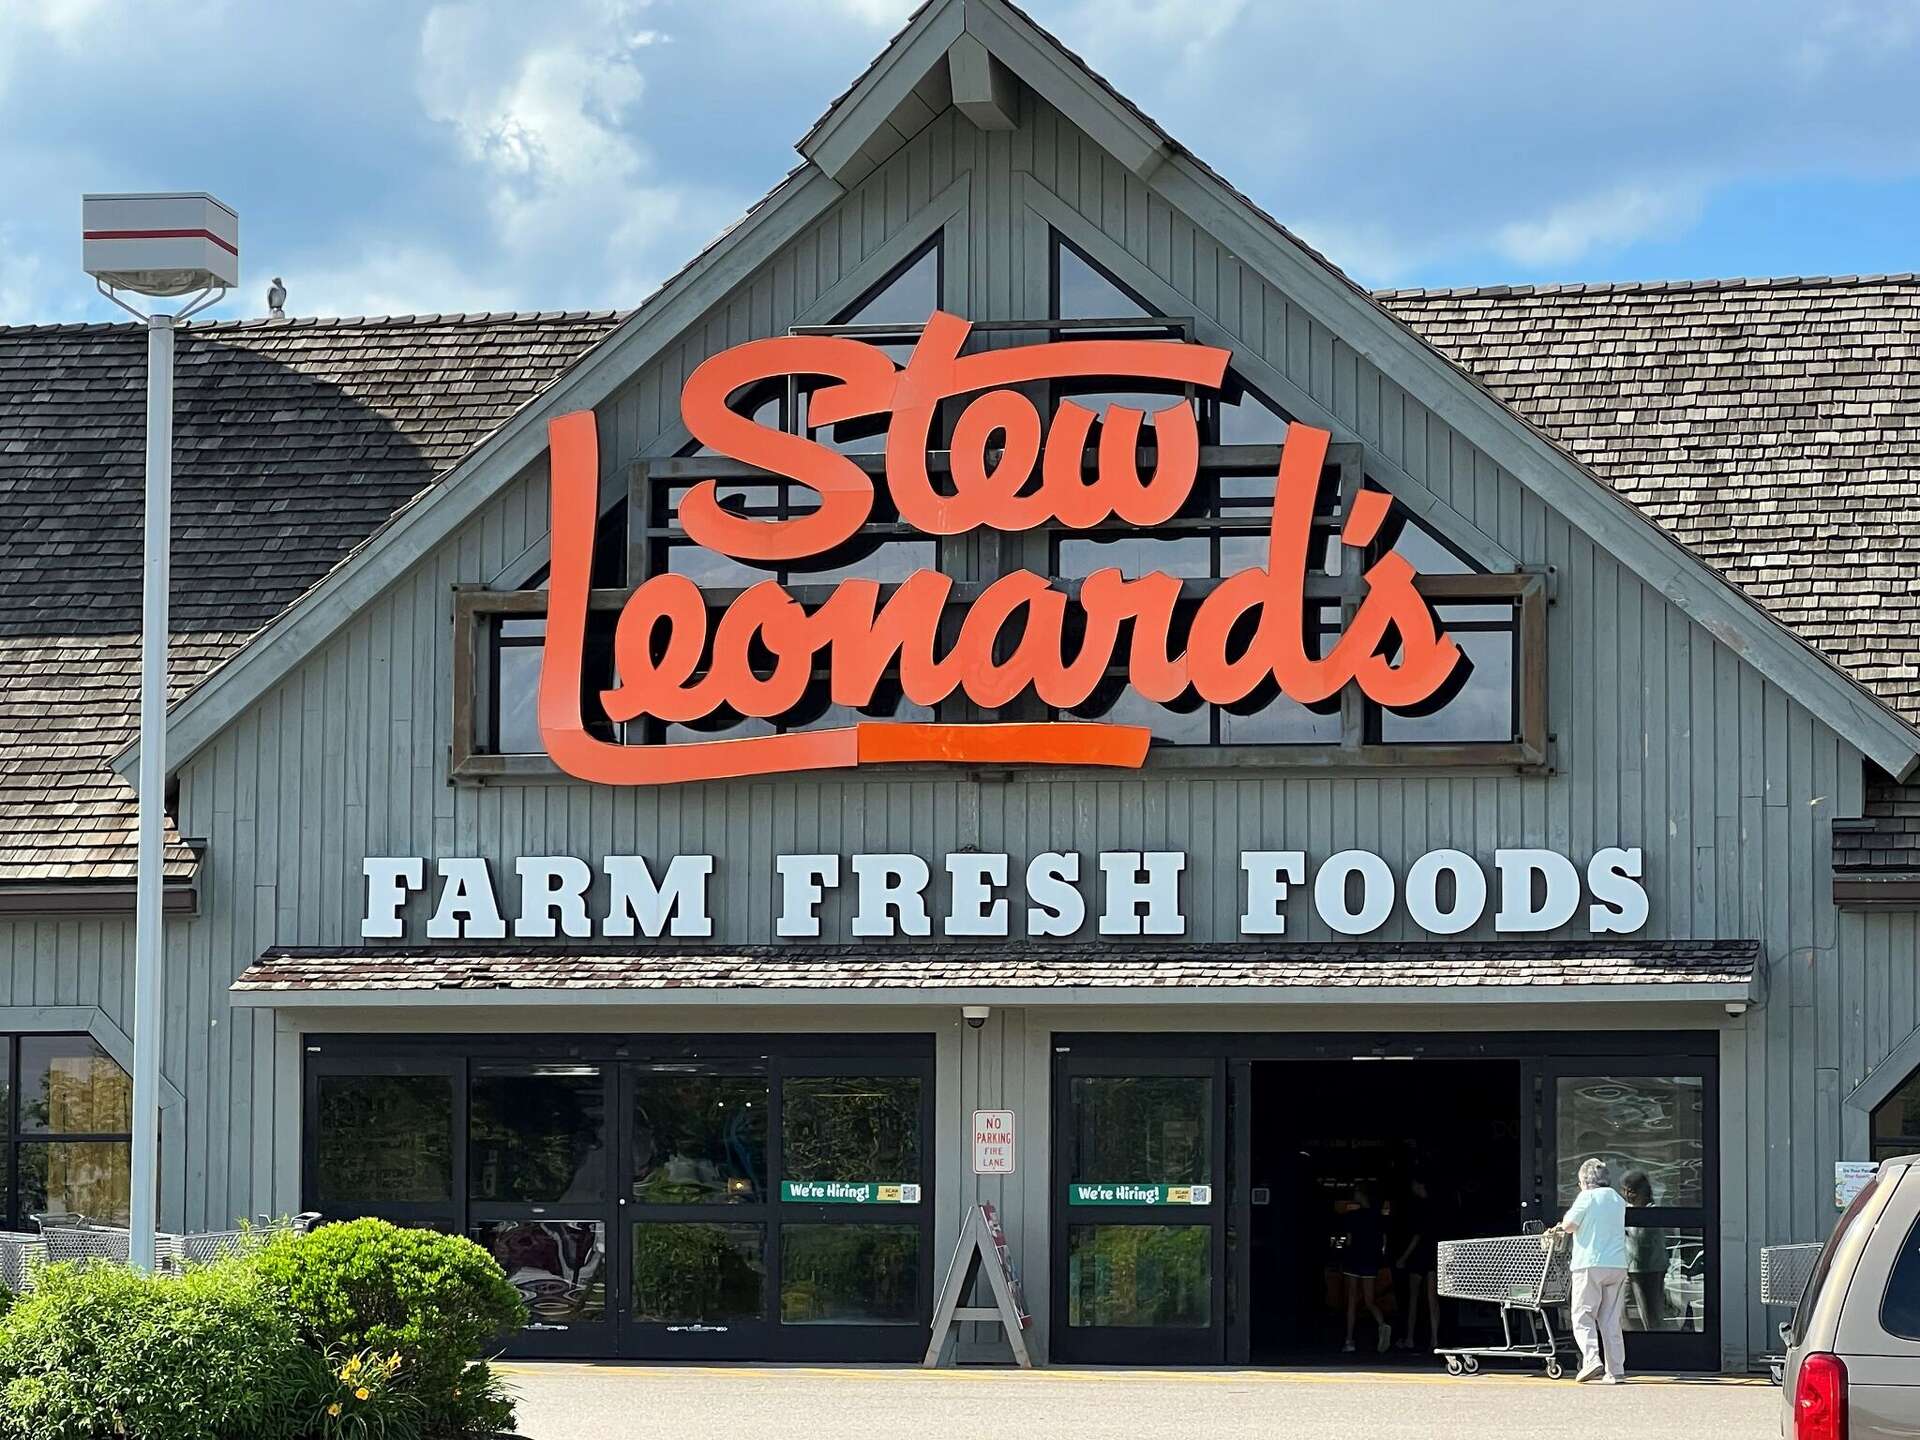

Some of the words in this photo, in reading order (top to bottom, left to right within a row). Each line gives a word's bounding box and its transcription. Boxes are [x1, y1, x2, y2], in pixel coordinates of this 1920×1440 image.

[679, 310, 1231, 560] Stew
[539, 410, 1461, 785] Leonard's
[361, 856, 714, 939] FARM
[776, 851, 1186, 938] FRESH
[1240, 847, 1650, 935] FOODS
[986, 1118, 1002, 1129] NO
[976, 1132, 1011, 1144] PARKING
[984, 1147, 1004, 1155] FIRE
[983, 1158, 1005, 1166] LANE
[790, 1182, 825, 1197] We're
[826, 1183, 870, 1202] Hiring!
[1078, 1185, 1115, 1200] We're
[1115, 1185, 1160, 1204] Hiring!
